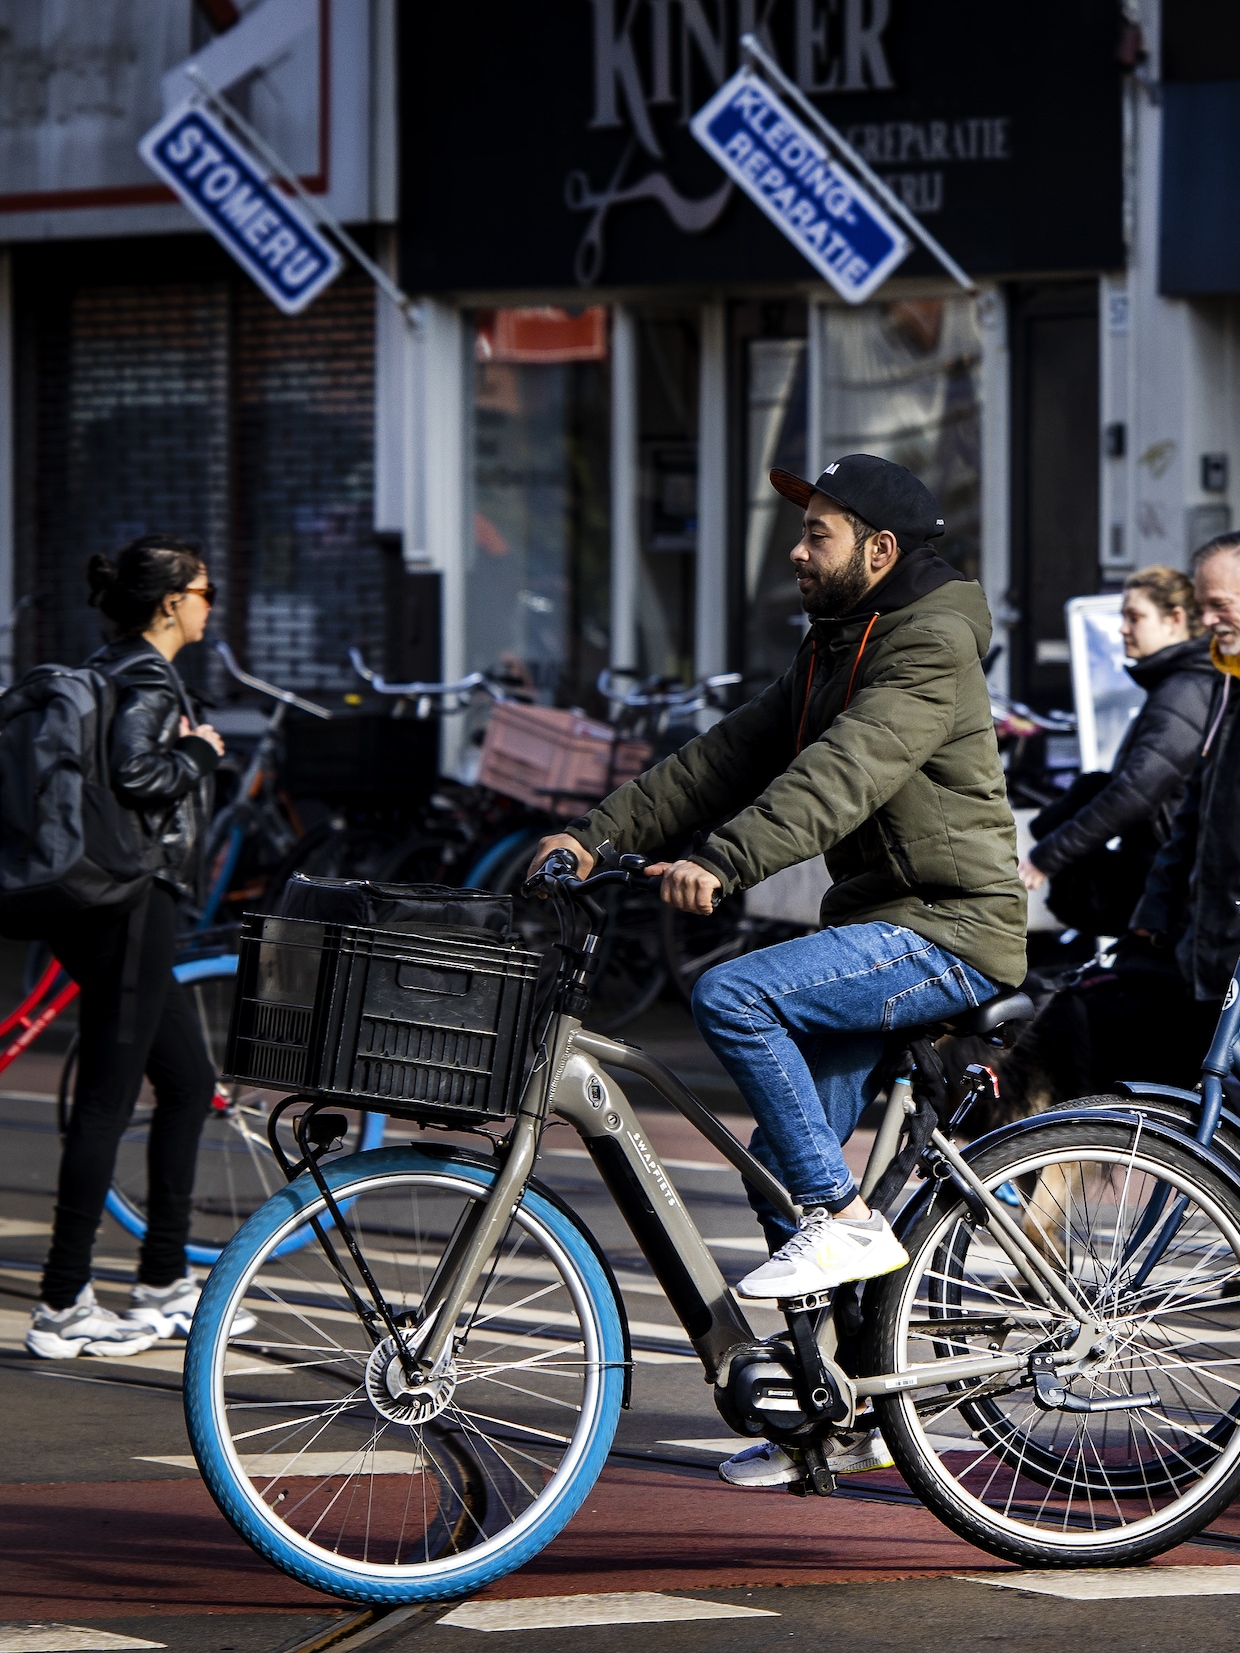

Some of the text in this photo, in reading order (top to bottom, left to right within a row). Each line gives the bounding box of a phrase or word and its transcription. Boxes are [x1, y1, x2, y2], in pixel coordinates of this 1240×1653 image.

[584, 0, 898, 160] KINKER
[723, 130, 871, 287] REPARATIE
[732, 92, 858, 226] KLEDING-
[633, 1132, 676, 1207] SWAPFIETS
